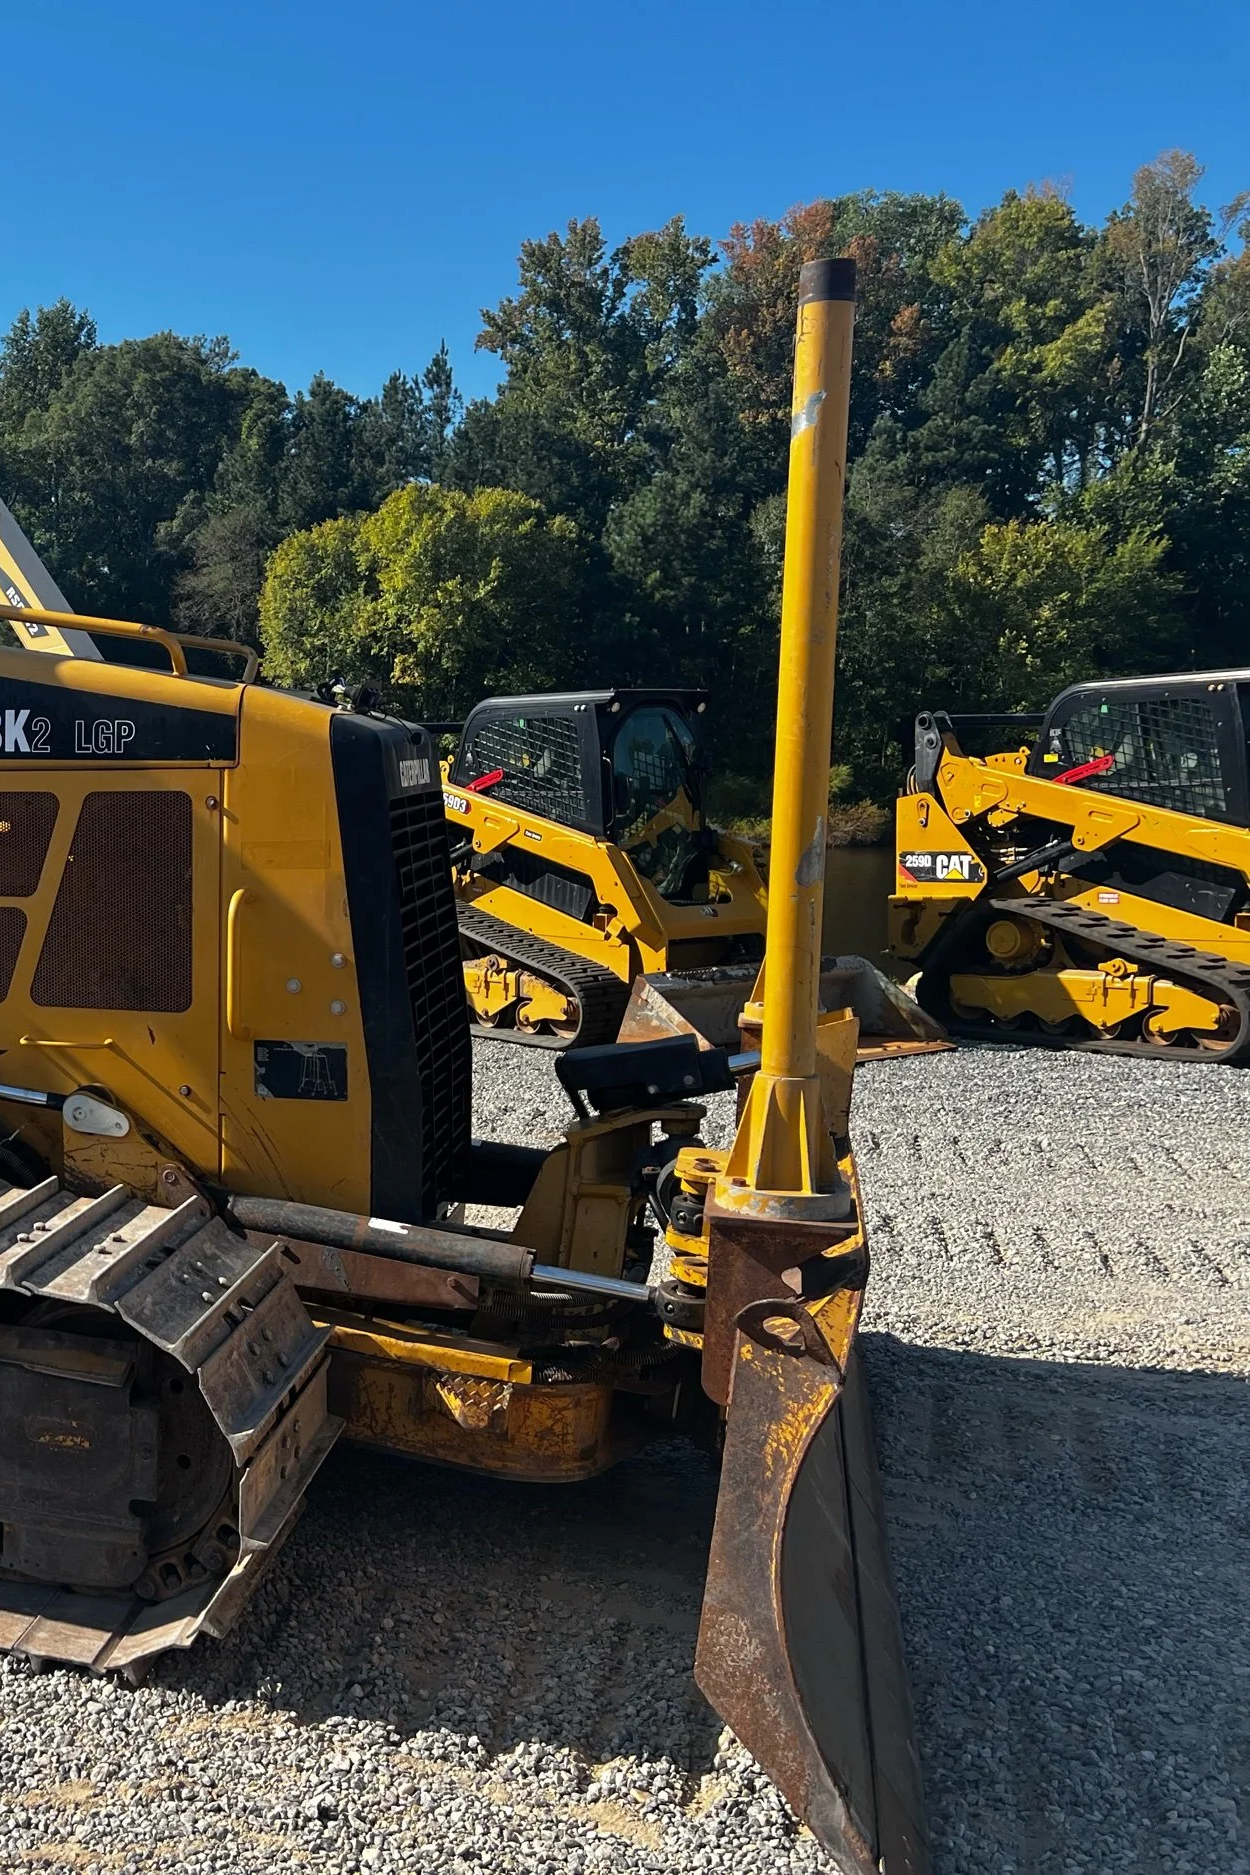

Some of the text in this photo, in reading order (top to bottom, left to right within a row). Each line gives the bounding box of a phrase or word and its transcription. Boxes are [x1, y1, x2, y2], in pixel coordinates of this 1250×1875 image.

[75, 720, 136, 753] LGP
[905, 854, 973, 879] 259D CAT
